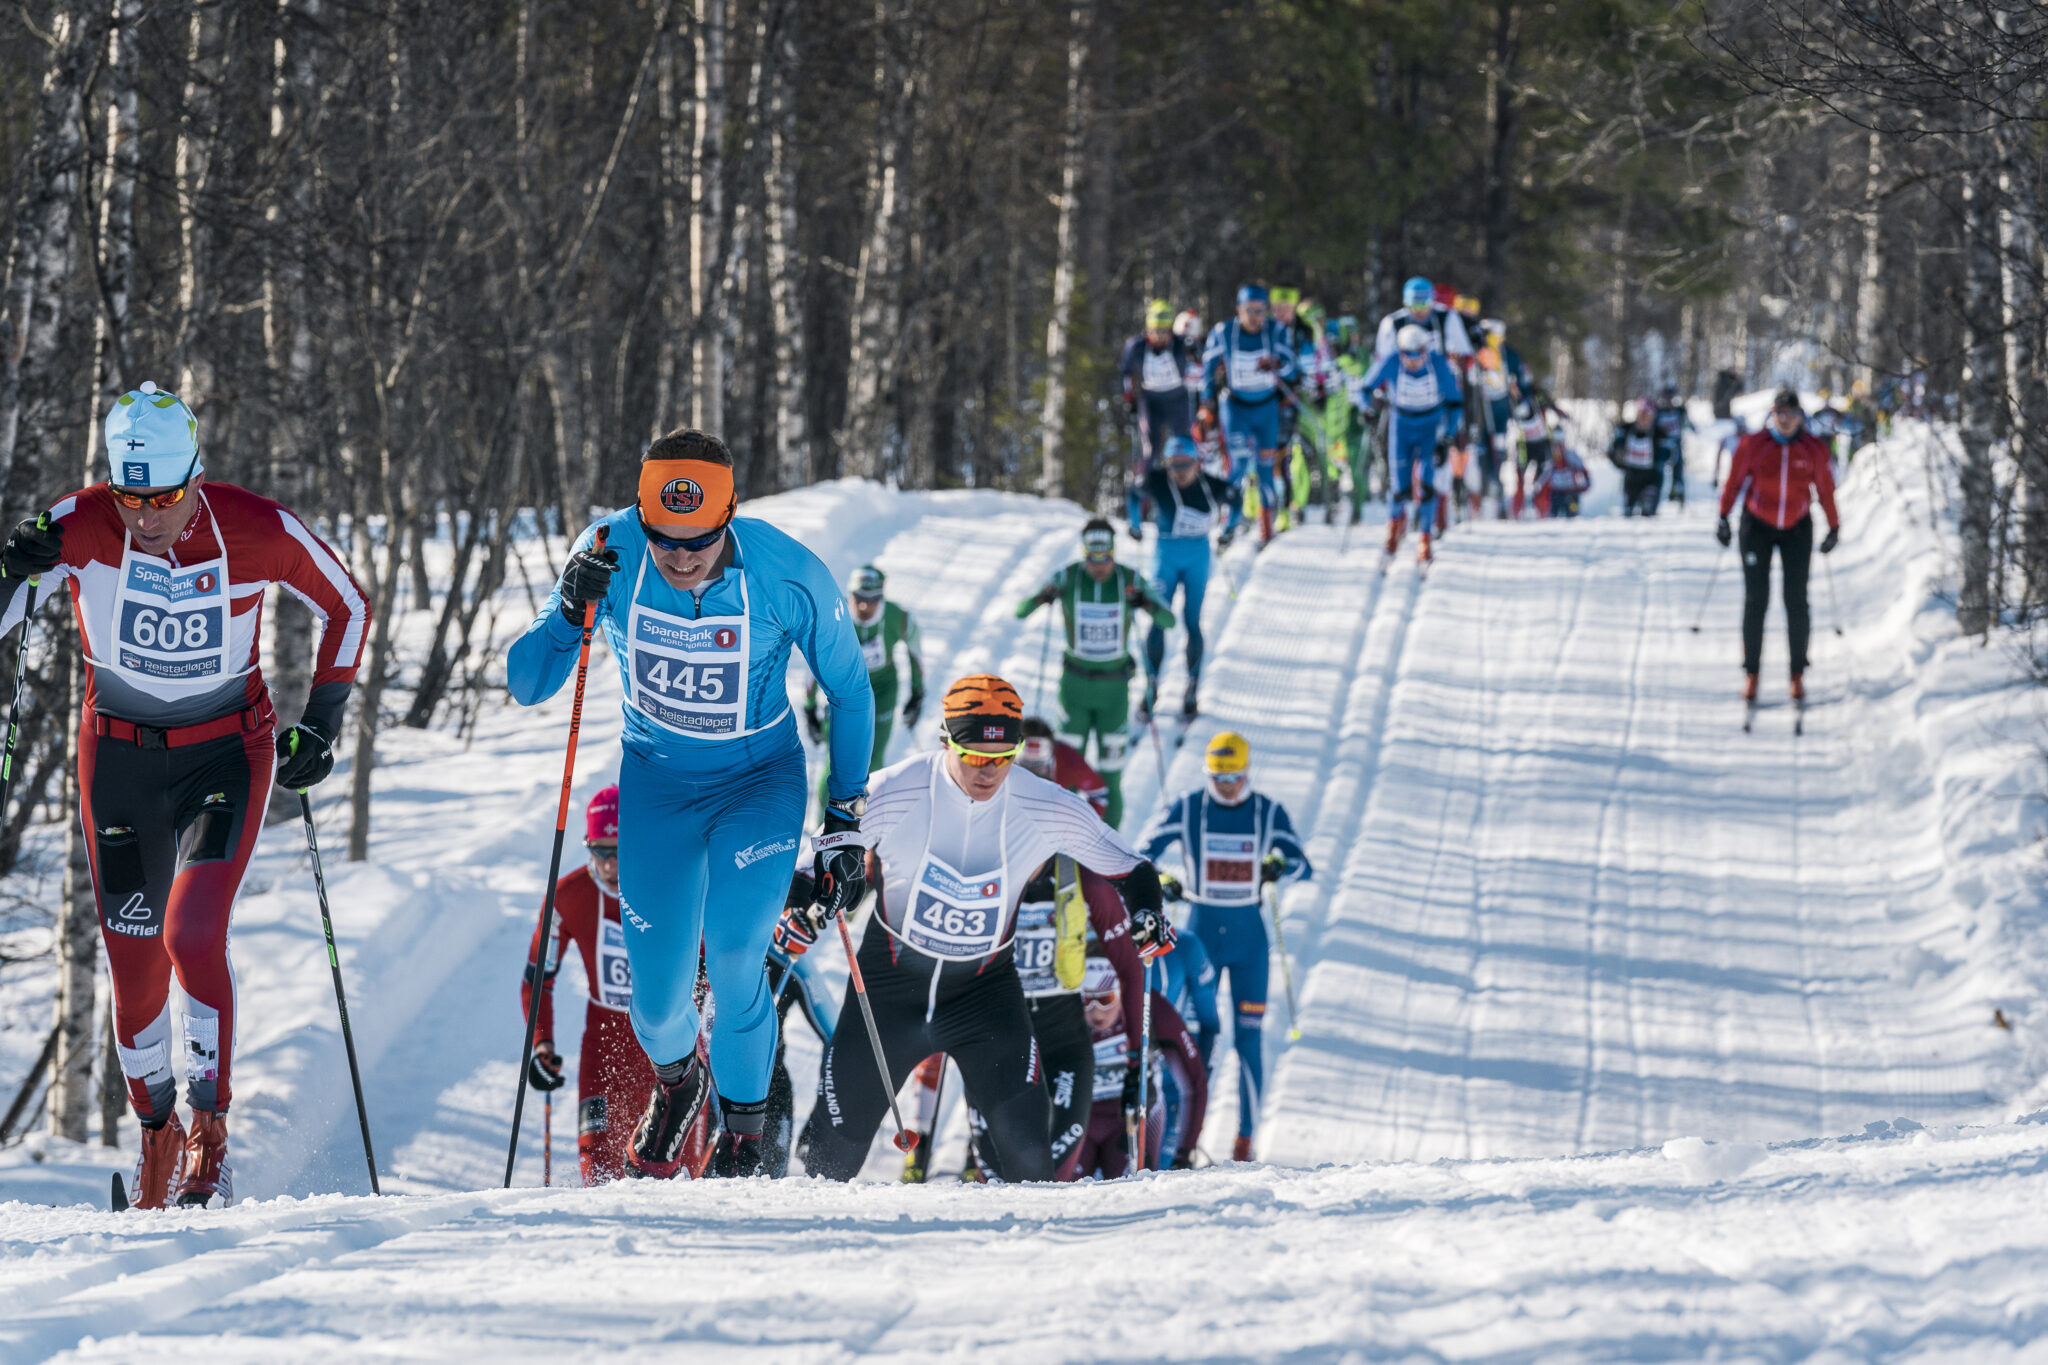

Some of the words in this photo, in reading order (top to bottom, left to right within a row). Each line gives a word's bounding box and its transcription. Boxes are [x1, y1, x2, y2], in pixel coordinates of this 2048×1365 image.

[662, 492, 702, 507] TSI
[201, 575, 209, 590] 1
[133, 608, 209, 651] 608
[642, 620, 713, 642] SpareBank
[721, 631, 730, 645] 1
[660, 636, 713, 650] NORD-NORGE
[144, 658, 217, 674] Reistadløpet
[647, 659, 724, 701] 445
[659, 706, 733, 728] Reistadløpet
[986, 884, 994, 895] 1
[619, 891, 653, 933] MTEX
[922, 900, 987, 936] 463
[106, 917, 160, 937] Löffler
[1051, 1123, 1084, 1159] SKO
